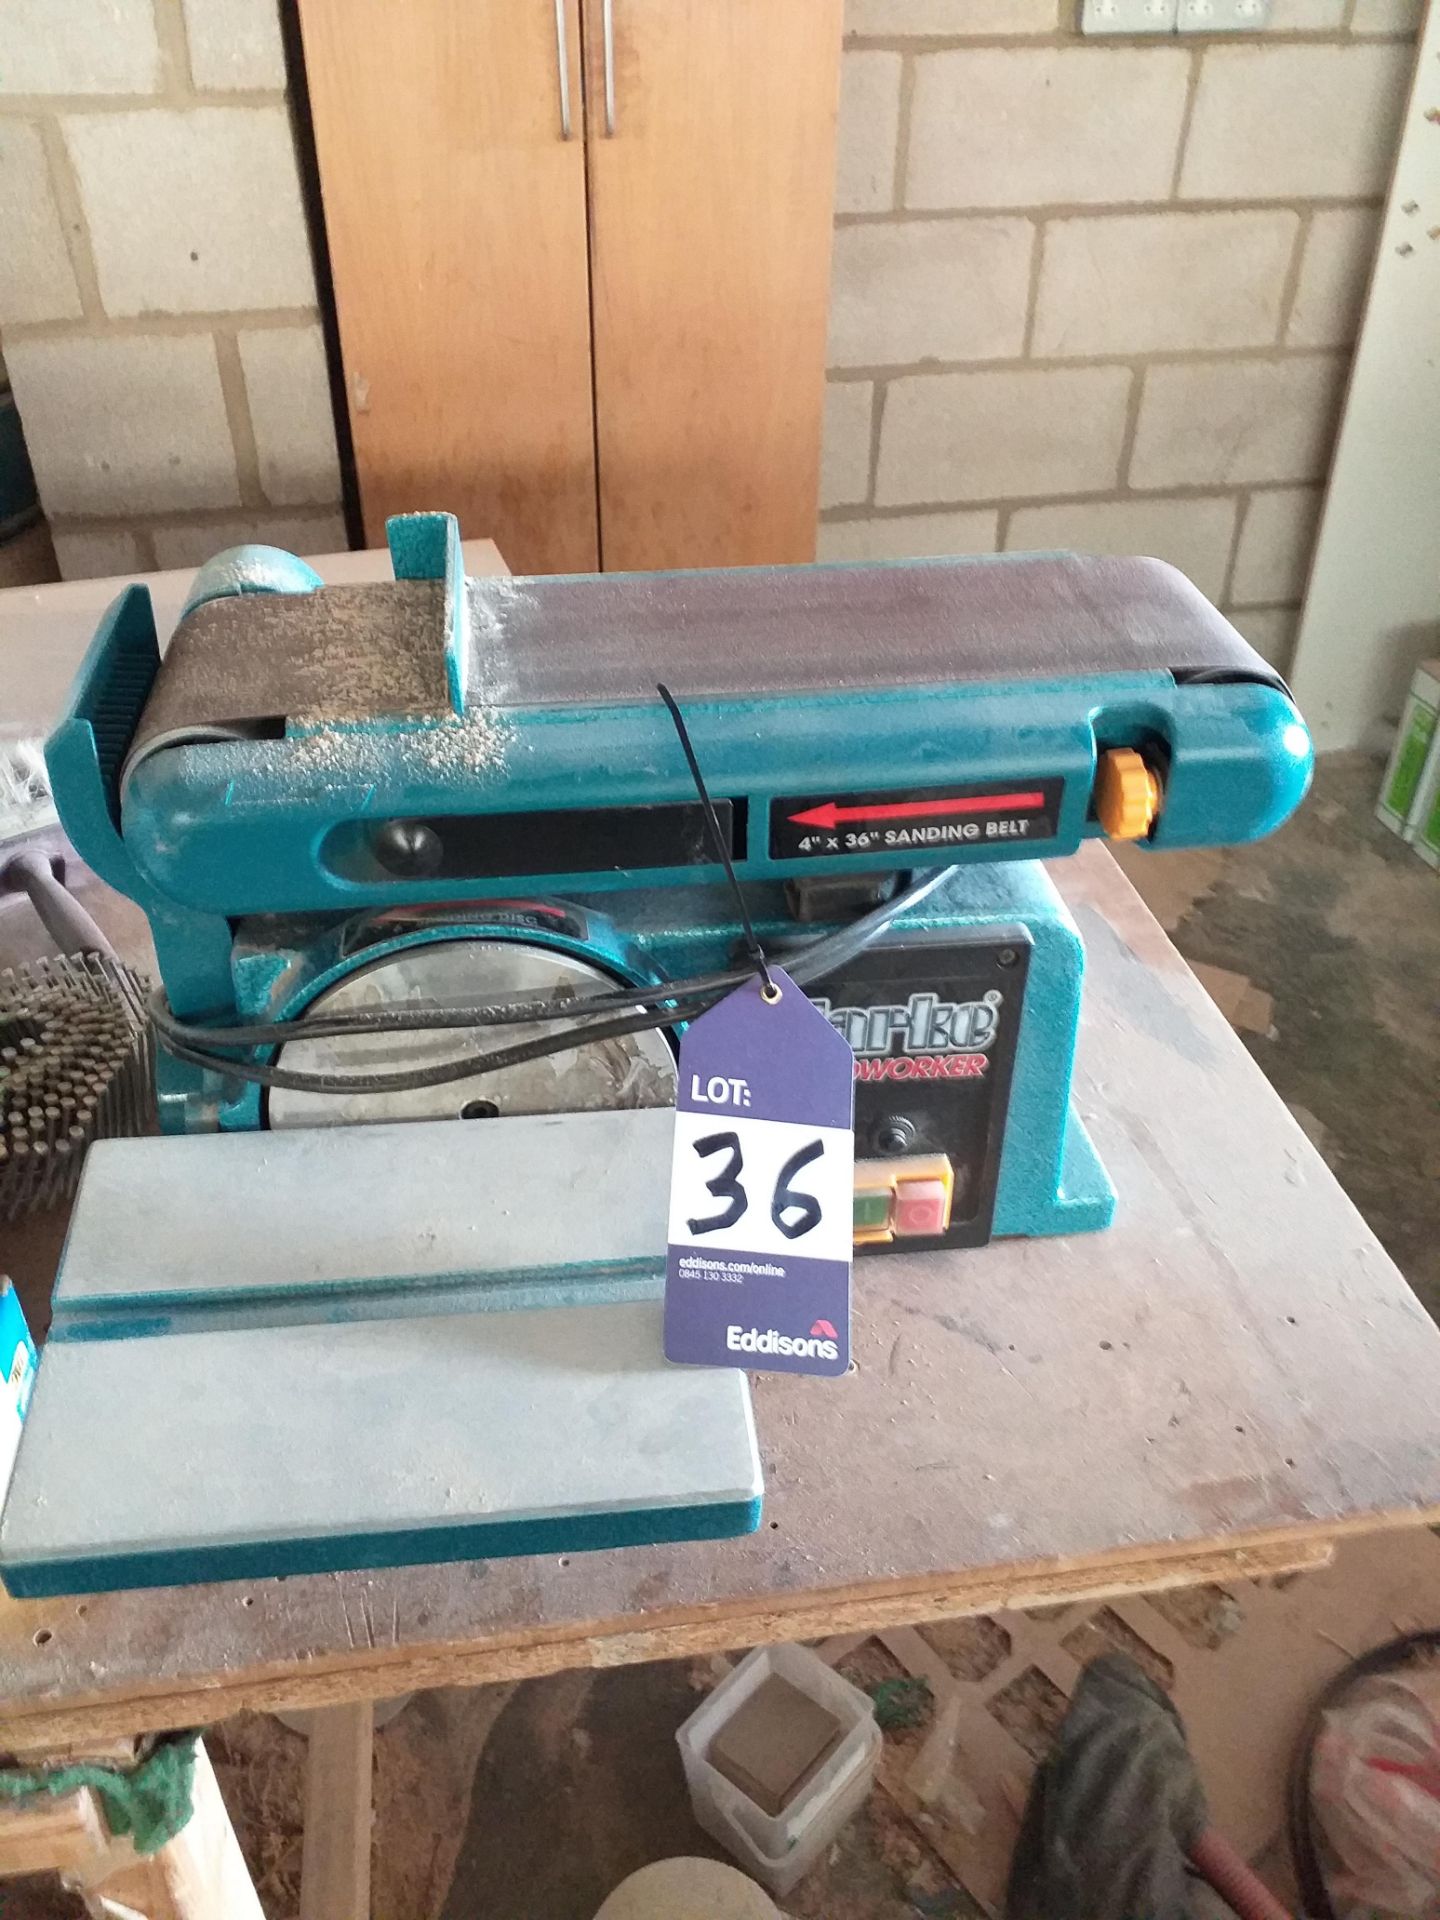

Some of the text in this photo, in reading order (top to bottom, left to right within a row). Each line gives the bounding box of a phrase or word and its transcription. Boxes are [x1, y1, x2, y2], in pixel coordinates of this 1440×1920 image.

[798, 836, 820, 851] 4"
[844, 831, 879, 848] 36"
[884, 822, 979, 845] SANDING
[985, 818, 1029, 836] BELT
[691, 1075, 751, 1107] LOT:
[678, 1256, 786, 1277] eddisons.com/online
[678, 1268, 744, 1284] 0845 130 3332
[727, 1325, 839, 1360] Eddisons
